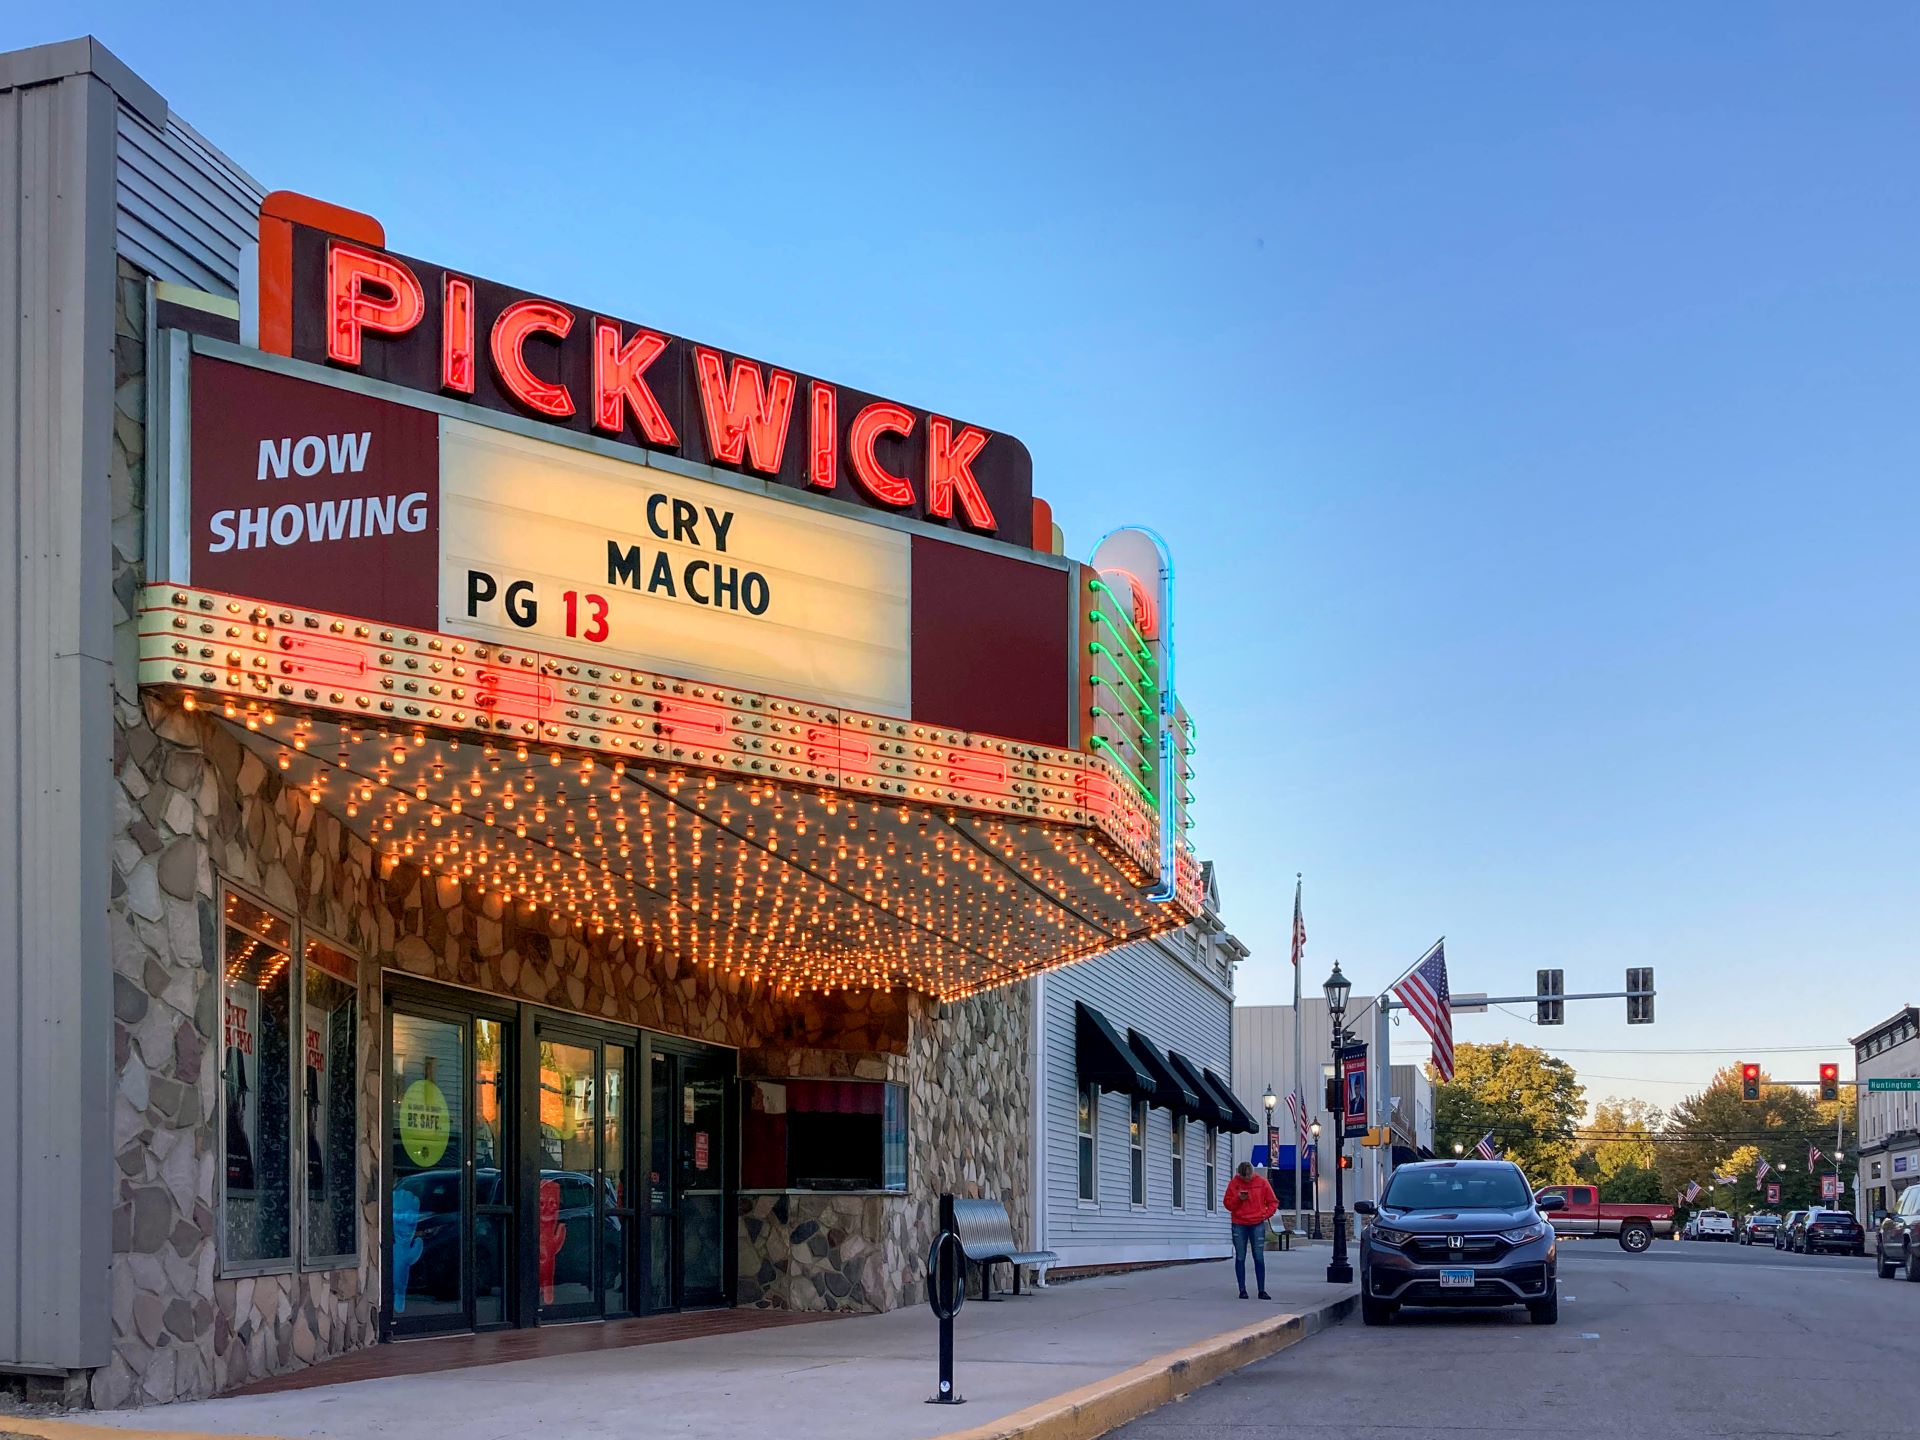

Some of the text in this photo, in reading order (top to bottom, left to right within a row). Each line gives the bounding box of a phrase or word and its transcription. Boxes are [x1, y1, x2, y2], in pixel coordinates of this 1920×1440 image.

[327, 238, 998, 532] PICKWICK
[257, 432, 372, 481] NOW
[209, 492, 428, 553] SHOWING
[646, 493, 734, 552] CRY
[467, 570, 609, 643] PG 13
[608, 541, 770, 616] MACHO
[225, 1026, 252, 1055] ACHO
[1871, 1081, 1912, 1089] Huntington
[408, 1112, 442, 1130] BE SAFE.
